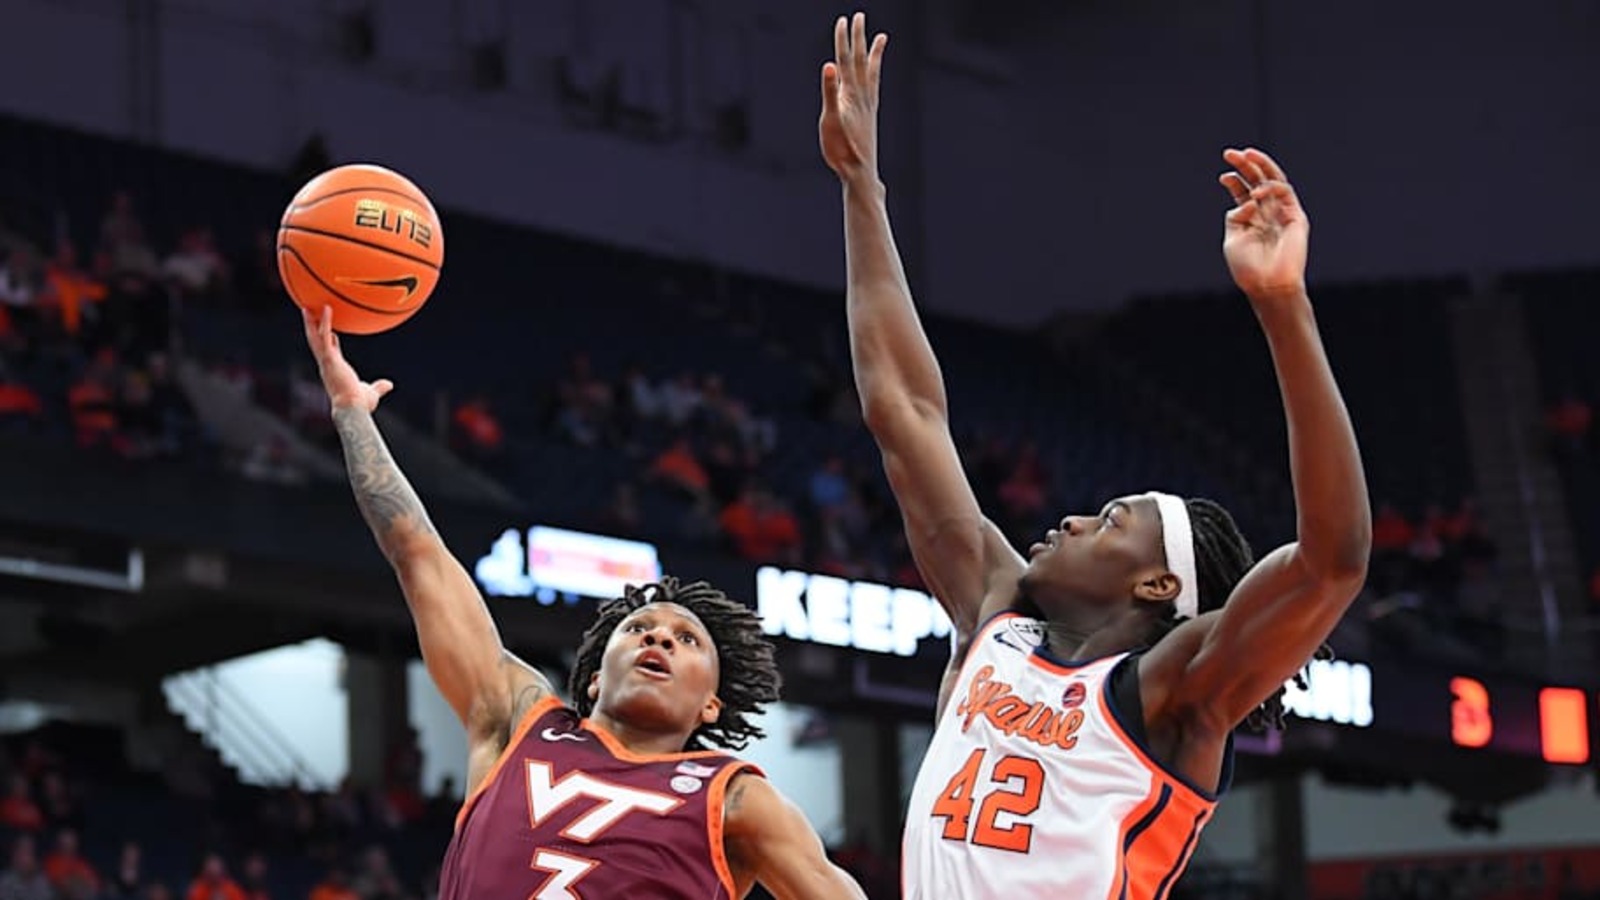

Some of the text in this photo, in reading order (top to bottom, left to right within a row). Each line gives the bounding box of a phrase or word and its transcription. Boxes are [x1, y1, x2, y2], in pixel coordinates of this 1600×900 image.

[355, 205, 431, 248] ELITE
[957, 665, 1086, 750] Syrause
[525, 758, 687, 843] VT
[930, 748, 1046, 854] 42
